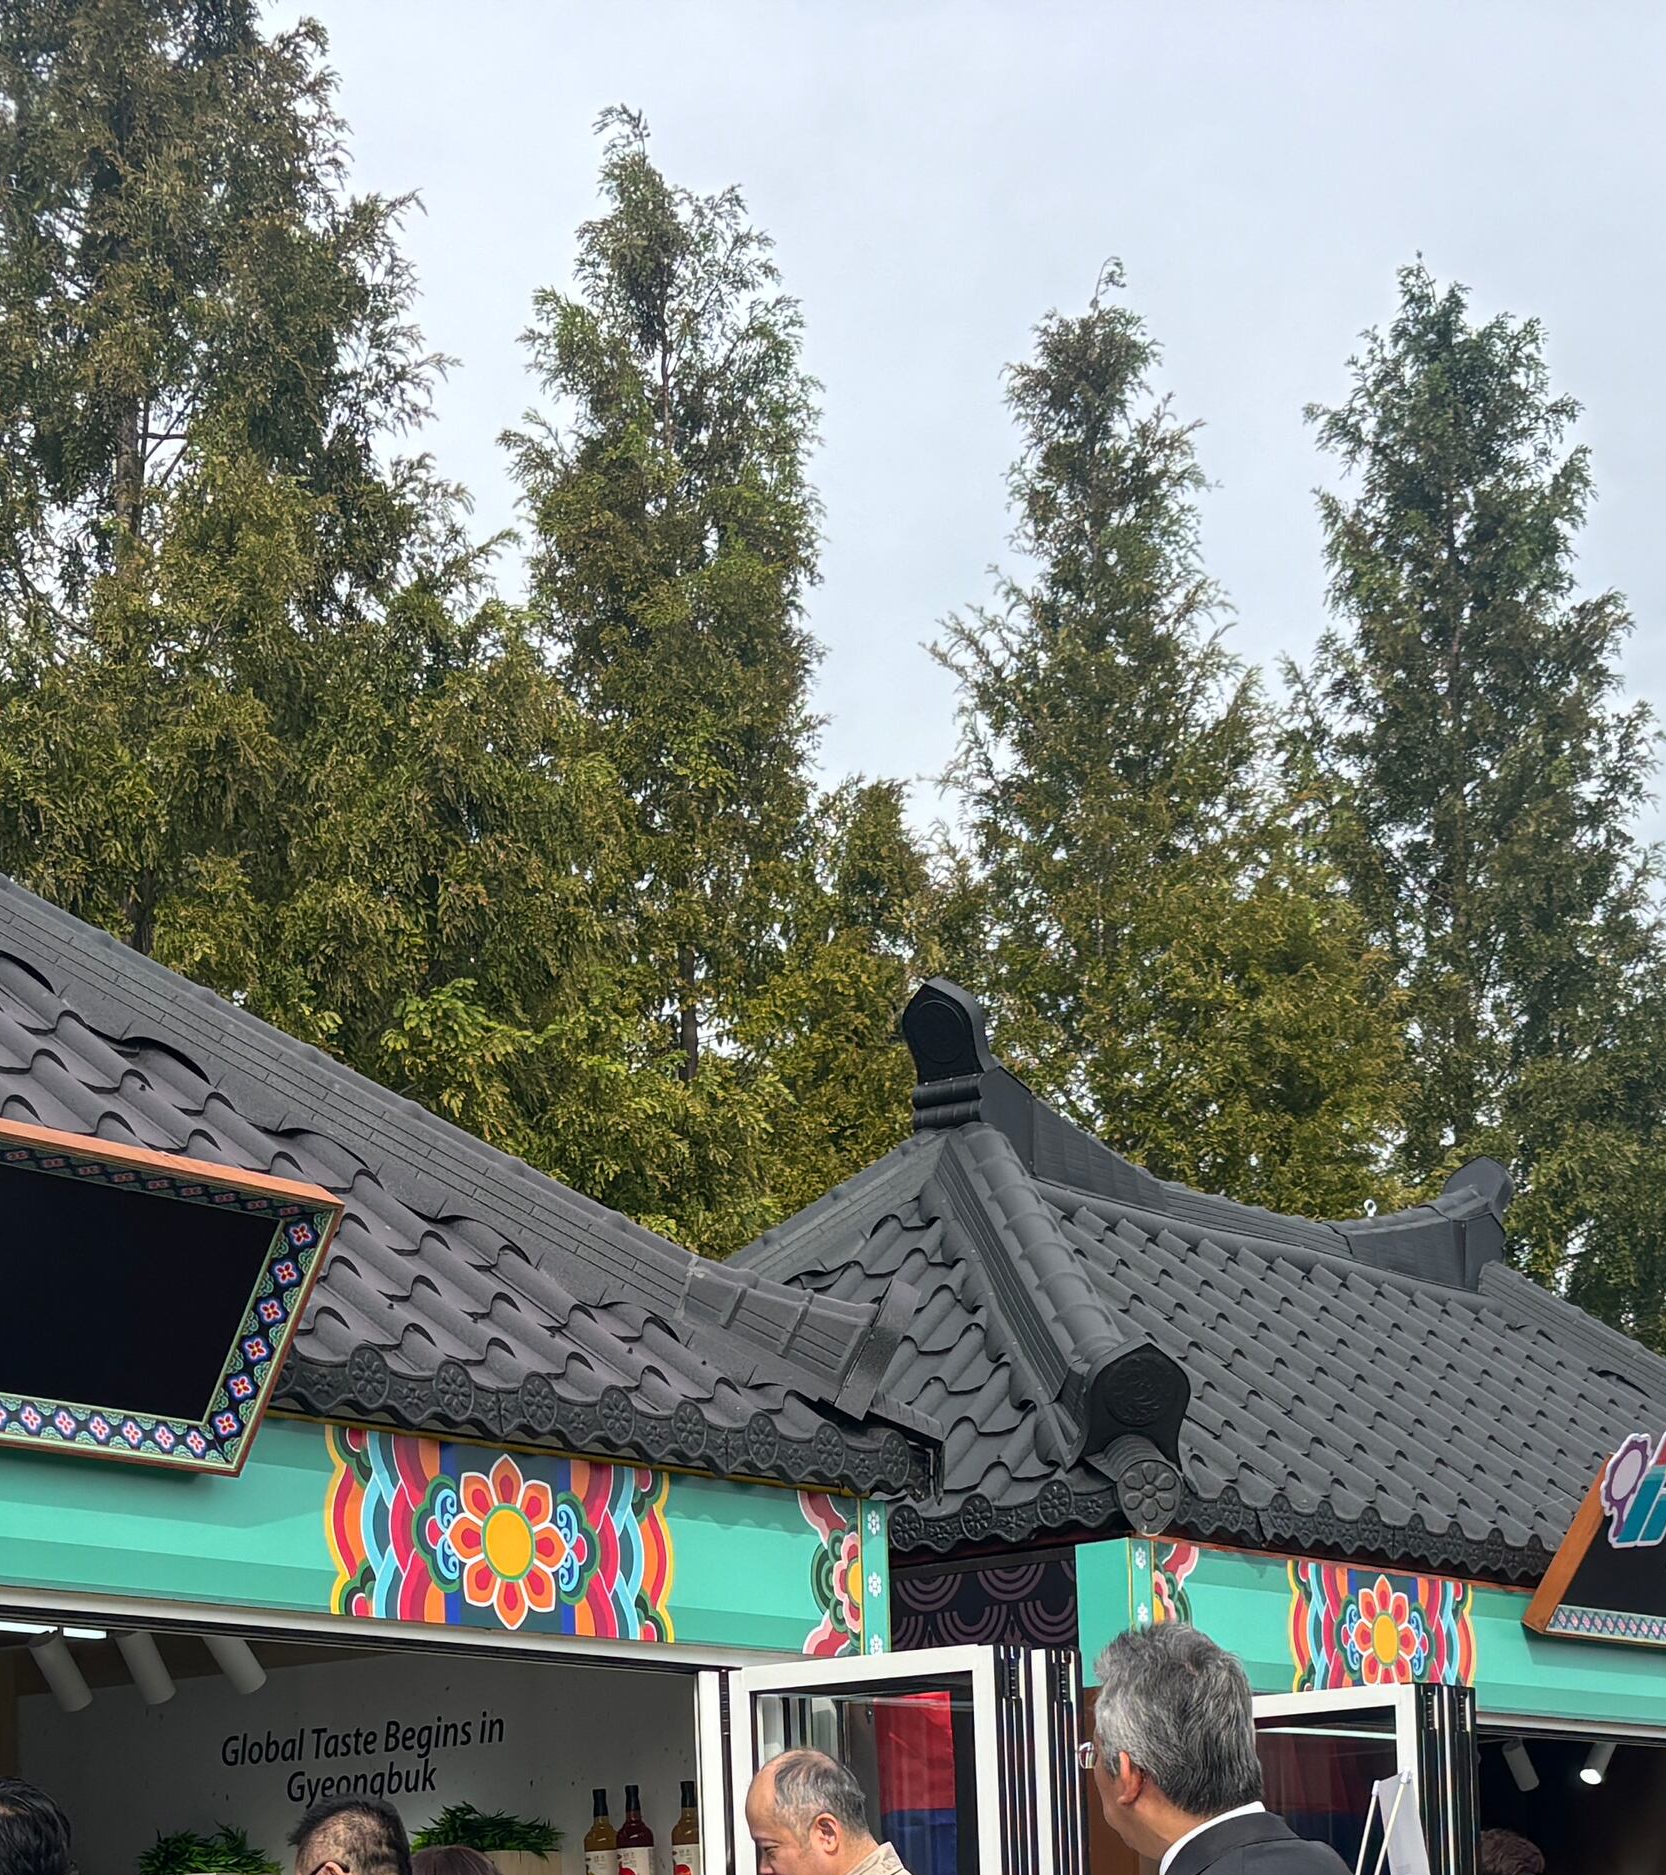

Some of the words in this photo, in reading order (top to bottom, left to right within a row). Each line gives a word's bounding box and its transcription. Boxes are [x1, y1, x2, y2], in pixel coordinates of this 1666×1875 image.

[222, 1729, 305, 1767] Global
[311, 1727, 377, 1760] Taste
[384, 1716, 472, 1758] Begins
[479, 1710, 504, 1744] in
[287, 1758, 437, 1809] Gyeongbuk
